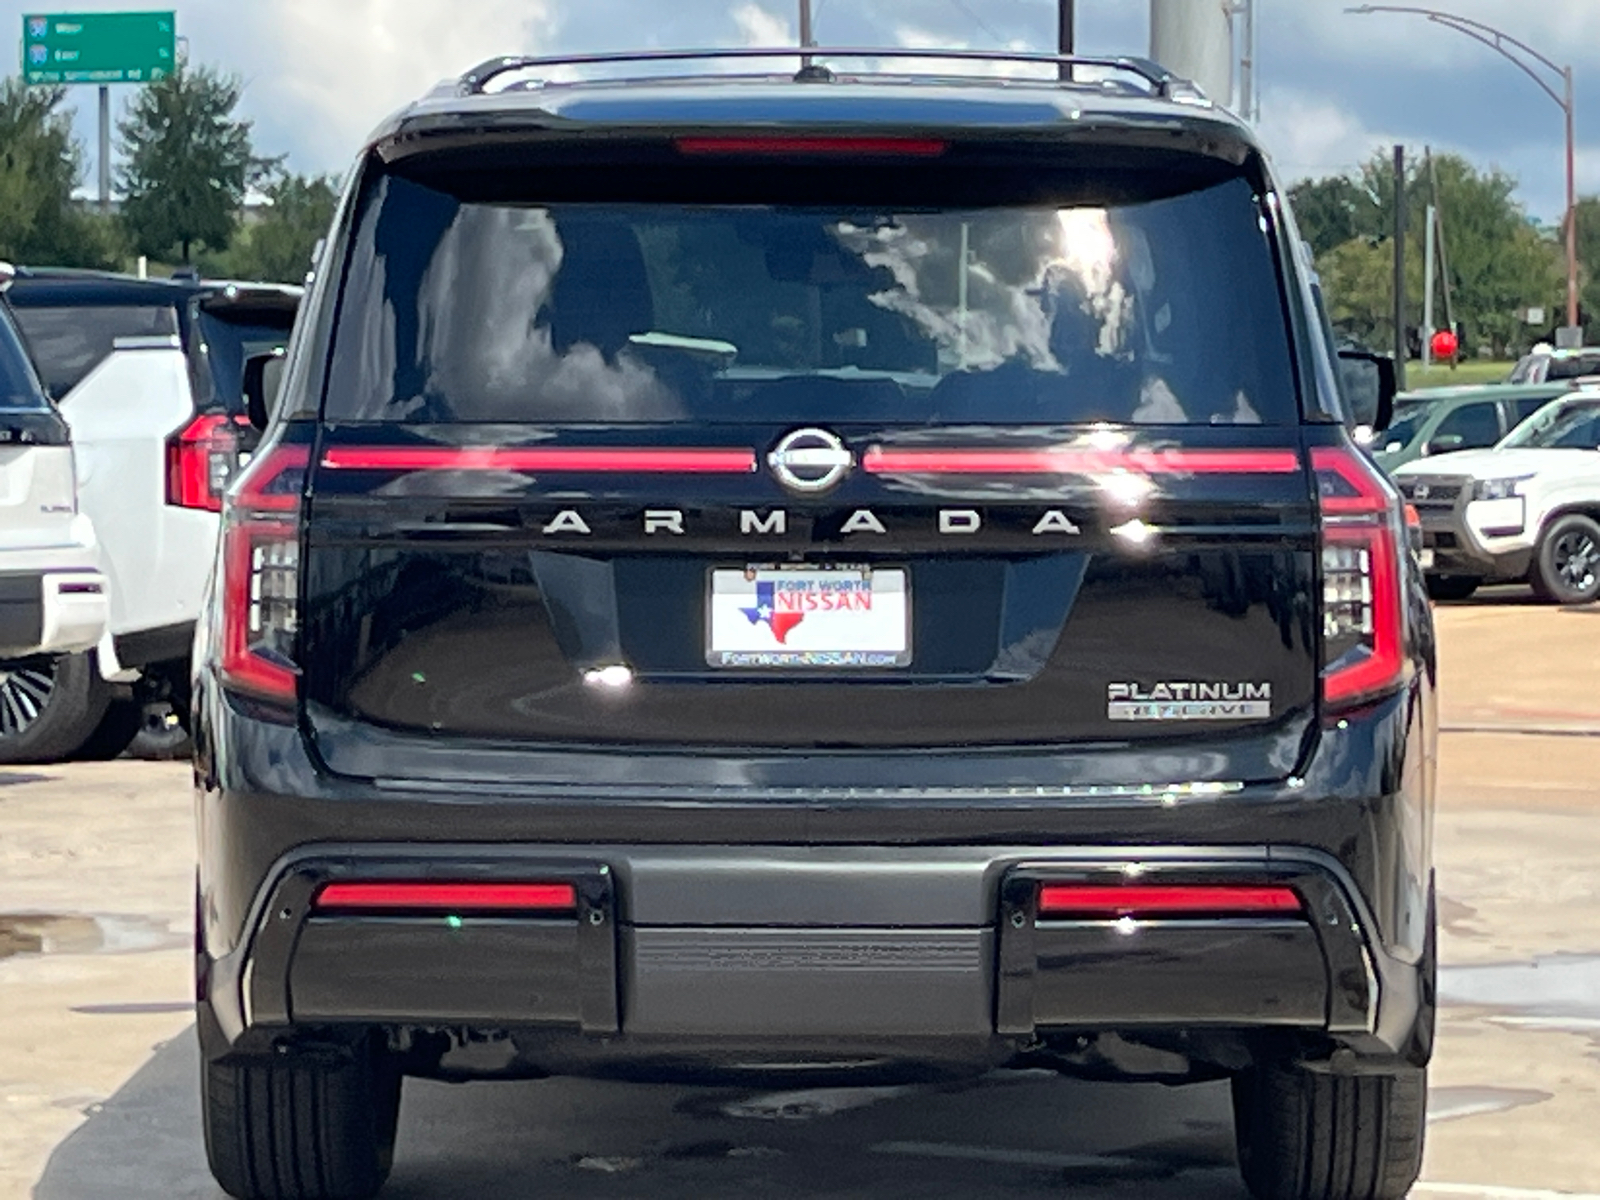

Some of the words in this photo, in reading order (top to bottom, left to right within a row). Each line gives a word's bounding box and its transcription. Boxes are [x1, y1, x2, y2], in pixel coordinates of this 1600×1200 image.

[542, 509, 1081, 534] ARMADA
[777, 580, 814, 591] FORT
[818, 580, 872, 591] WORTH
[777, 592, 872, 610] NISSAN
[1107, 682, 1271, 700] PLATINUM
